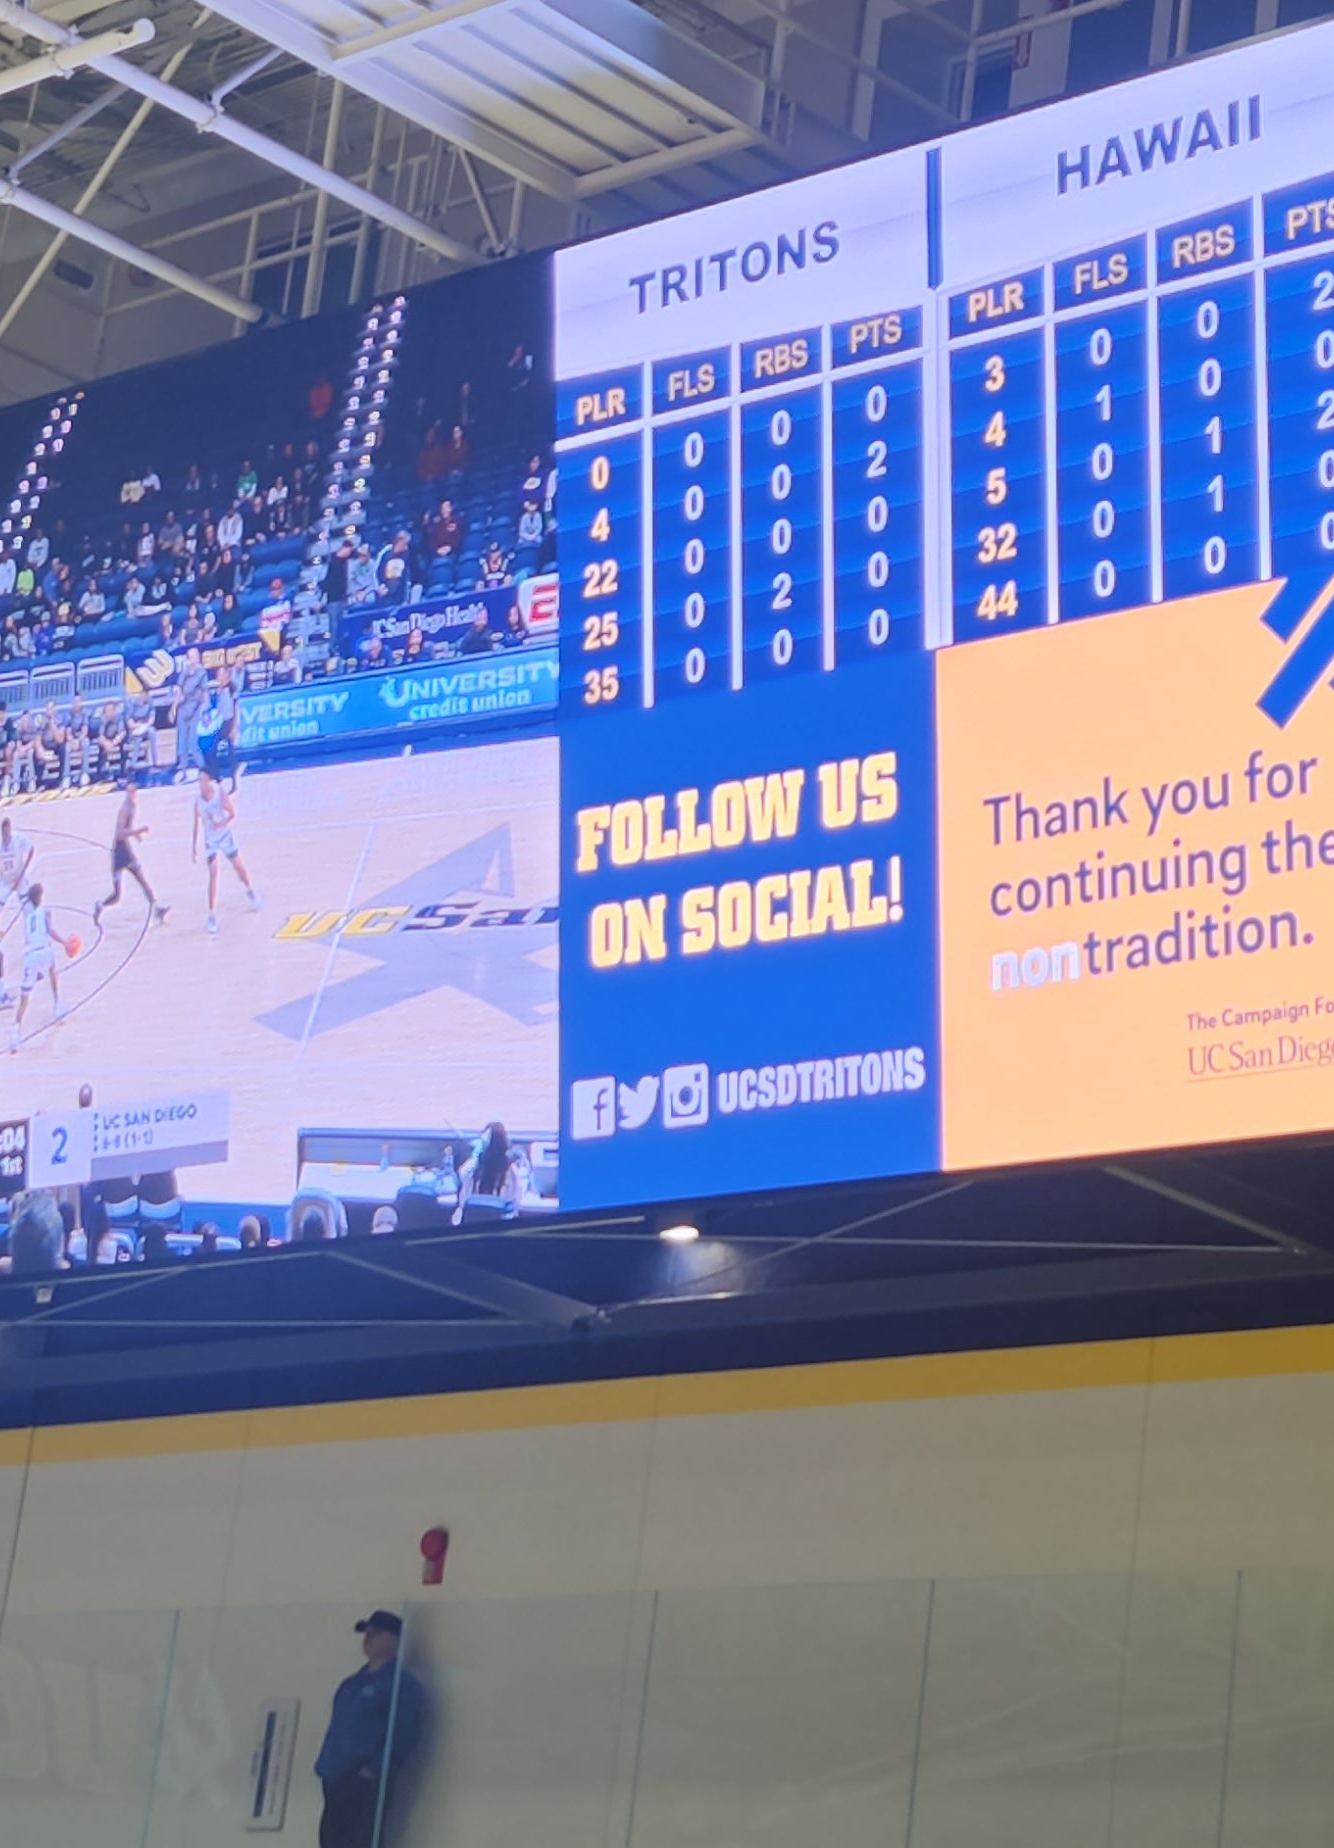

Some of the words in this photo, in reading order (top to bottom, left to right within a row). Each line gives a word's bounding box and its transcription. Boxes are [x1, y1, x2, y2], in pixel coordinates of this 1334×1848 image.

[1056, 94, 1262, 196] HAWAII
[628, 220, 840, 314] TRITONS
[967, 281, 1025, 323] PLR
[1073, 253, 1129, 296] FLS
[1172, 224, 1236, 270] RBS
[575, 387, 627, 425] PLR
[668, 363, 716, 402] FLS
[754, 338, 810, 379] RBS
[849, 314, 903, 353] PTS
[984, 355, 1005, 392] 3
[1089, 327, 1112, 367] 0
[1196, 300, 1220, 340] 0
[590, 455, 610, 491] 0
[684, 431, 704, 468] 0
[771, 409, 792, 446] 0
[866, 385, 887, 423] 0
[984, 410, 1006, 449] 4
[1095, 384, 1111, 422] 1
[1198, 358, 1222, 398] 0
[590, 507, 611, 542] 4
[684, 485, 704, 521] 0
[771, 463, 792, 500] 0
[866, 440, 887, 479] 2
[985, 467, 1006, 506] 5
[1092, 442, 1114, 481] 0
[1204, 415, 1222, 454] 1
[582, 558, 618, 599] 22
[685, 538, 705, 575] 0
[772, 518, 792, 555] 0
[867, 496, 888, 533] 0
[976, 522, 1018, 565] 32
[1092, 499, 1115, 540] 0
[1206, 474, 1224, 513] 1
[582, 612, 619, 651] 25
[685, 592, 705, 628] 0
[772, 572, 792, 610] 2
[867, 551, 889, 589] 0
[976, 579, 1019, 622] 44
[1093, 558, 1116, 599] 0
[1203, 534, 1227, 575] 0
[383, 659, 559, 708] UNIVERSITY
[583, 666, 619, 705] 35
[685, 647, 706, 684] 0
[772, 628, 793, 666] 0
[868, 608, 889, 646] 0
[241, 691, 350, 724] VERSITY
[409, 693, 469, 721] credit
[472, 688, 531, 714] union
[576, 768, 804, 873] FOLLOW
[818, 751, 897, 829] US
[983, 776, 1129, 846] Thank
[1141, 772, 1229, 836] you
[1244, 749, 1318, 803] for
[273, 905, 412, 939] UC
[590, 894, 667, 969] ON
[681, 855, 903, 955] SOCIAL!
[990, 838, 1248, 918] continuing
[1186, 1012, 1217, 1031] The
[1221, 1001, 1310, 1027] Campaign
[1187, 1044, 1224, 1076] UC
[1228, 1039, 1273, 1070] San
[103, 1114, 119, 1131] UC
[124, 1109, 151, 1127] SAN
[154, 1103, 197, 1123] DIEGO
[717, 1046, 926, 1114] UCSDTRITONS
[51, 1126, 68, 1165] 2
